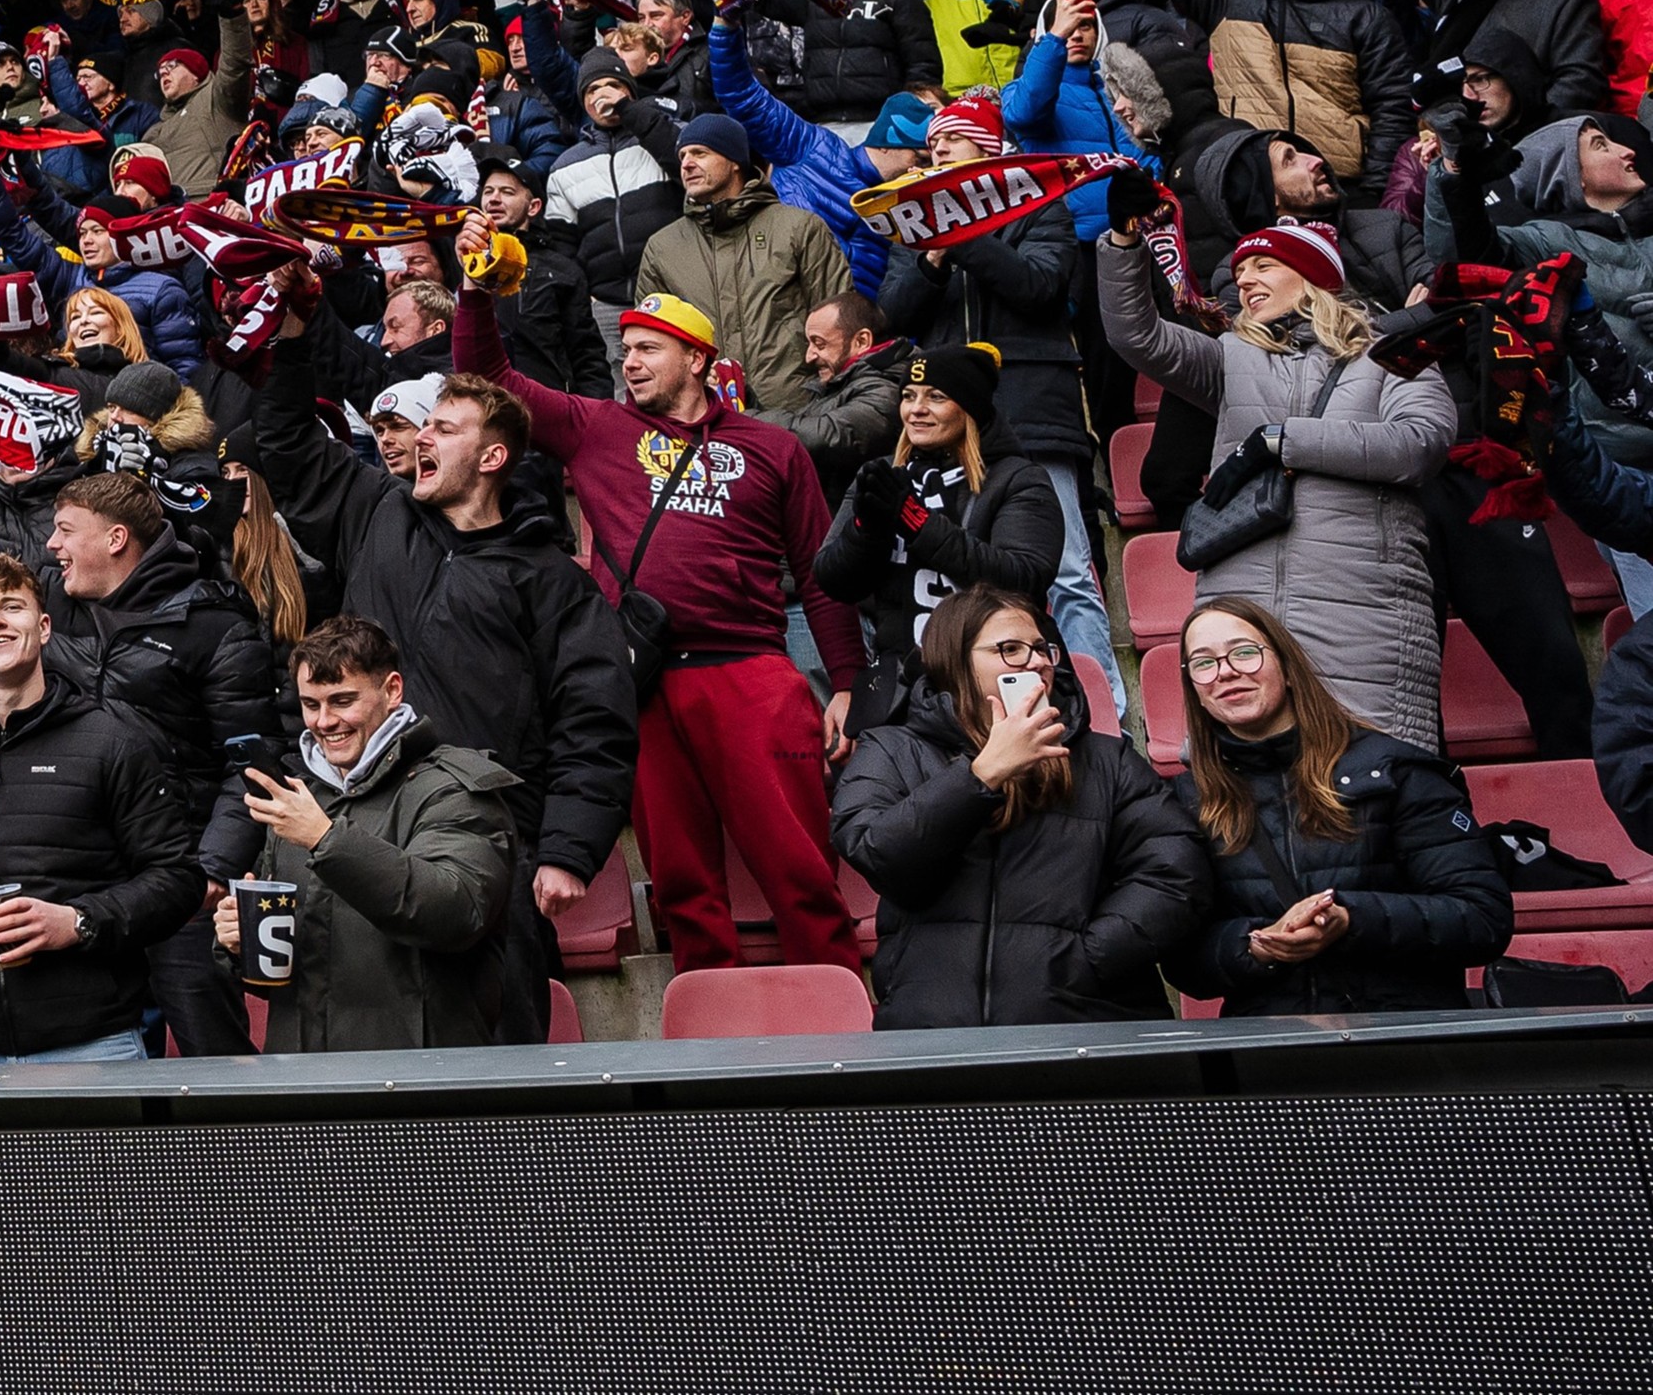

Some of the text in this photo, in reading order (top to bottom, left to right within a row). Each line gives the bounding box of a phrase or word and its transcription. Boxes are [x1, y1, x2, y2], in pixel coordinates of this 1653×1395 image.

[244, 142, 364, 223] PARTA
[910, 363, 925, 382] S
[650, 477, 732, 501] SARTA
[257, 915, 294, 979] S
